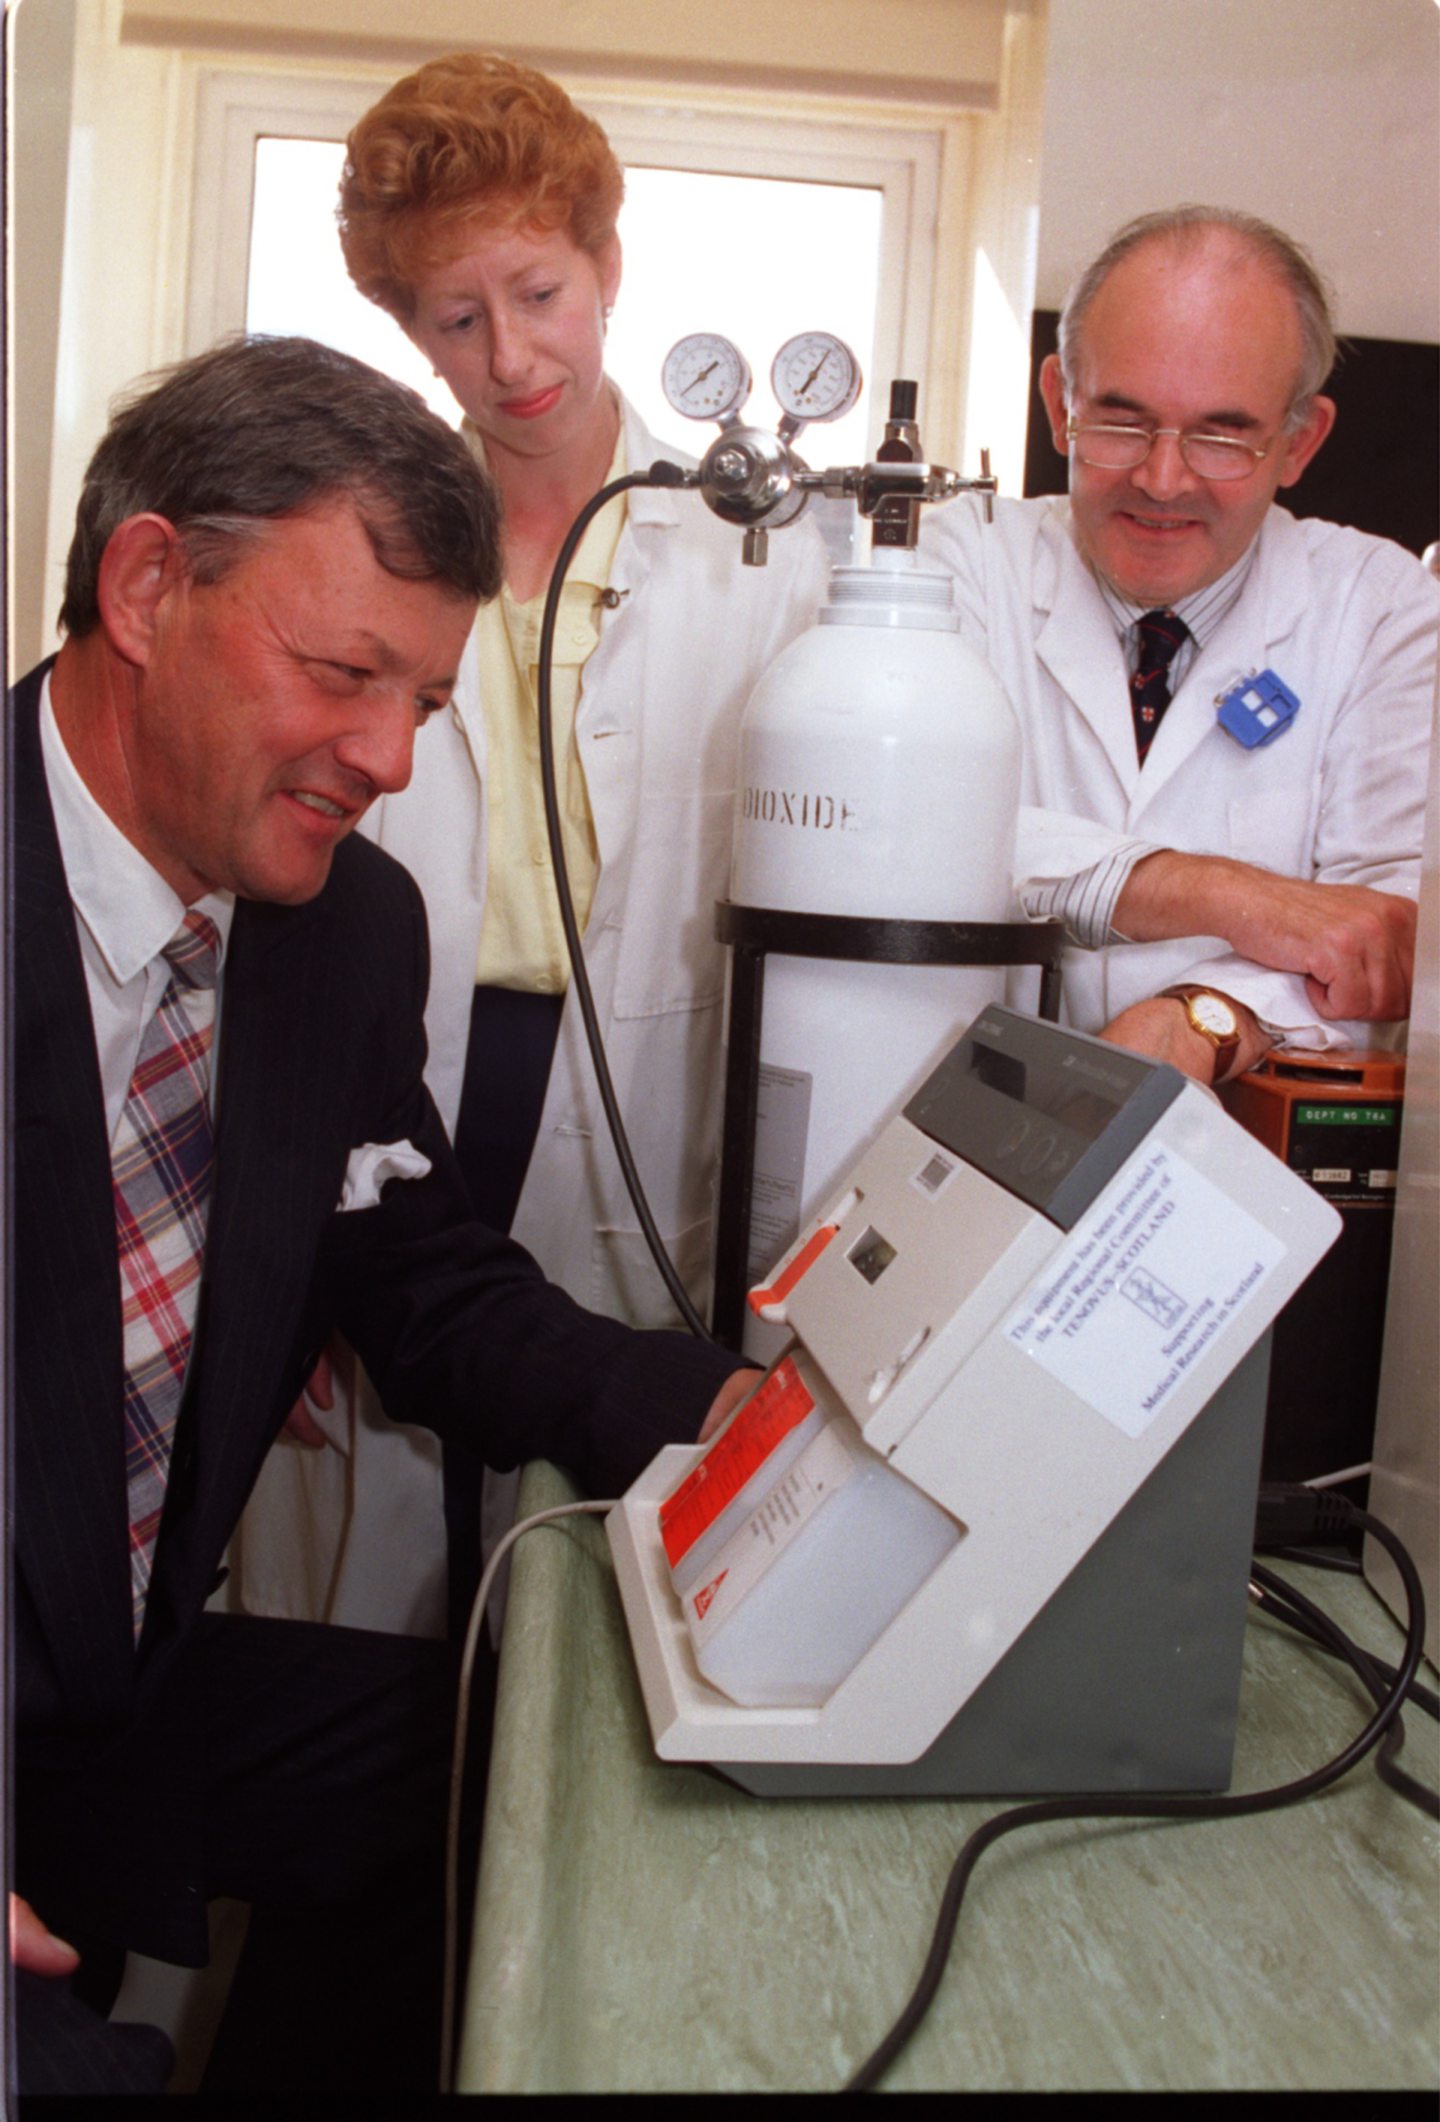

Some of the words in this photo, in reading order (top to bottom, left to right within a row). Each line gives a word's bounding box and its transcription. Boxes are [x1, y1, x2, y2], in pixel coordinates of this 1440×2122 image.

[1306, 1110, 1335, 1120] DEPT
[1343, 1111, 1358, 1121] NO
[1010, 1315, 1036, 1342] This
[1034, 1261, 1081, 1317] equipment
[1077, 1240, 1098, 1261] has
[1093, 1214, 1117, 1241] been
[1114, 1164, 1156, 1216] provided
[1150, 1153, 1168, 1169] by
[1035, 1324, 1054, 1343] the
[1051, 1295, 1076, 1324] local
[1071, 1247, 1113, 1299] Regional
[1109, 1187, 1162, 1249] Committee
[1160, 1173, 1173, 1189] of
[1141, 1363, 1181, 1412] Medical
[1175, 1320, 1220, 1370] Research
[1215, 1307, 1230, 1324] in
[1223, 1262, 1266, 1310] Scotland
[1161, 1296, 1217, 1358] Supporting
